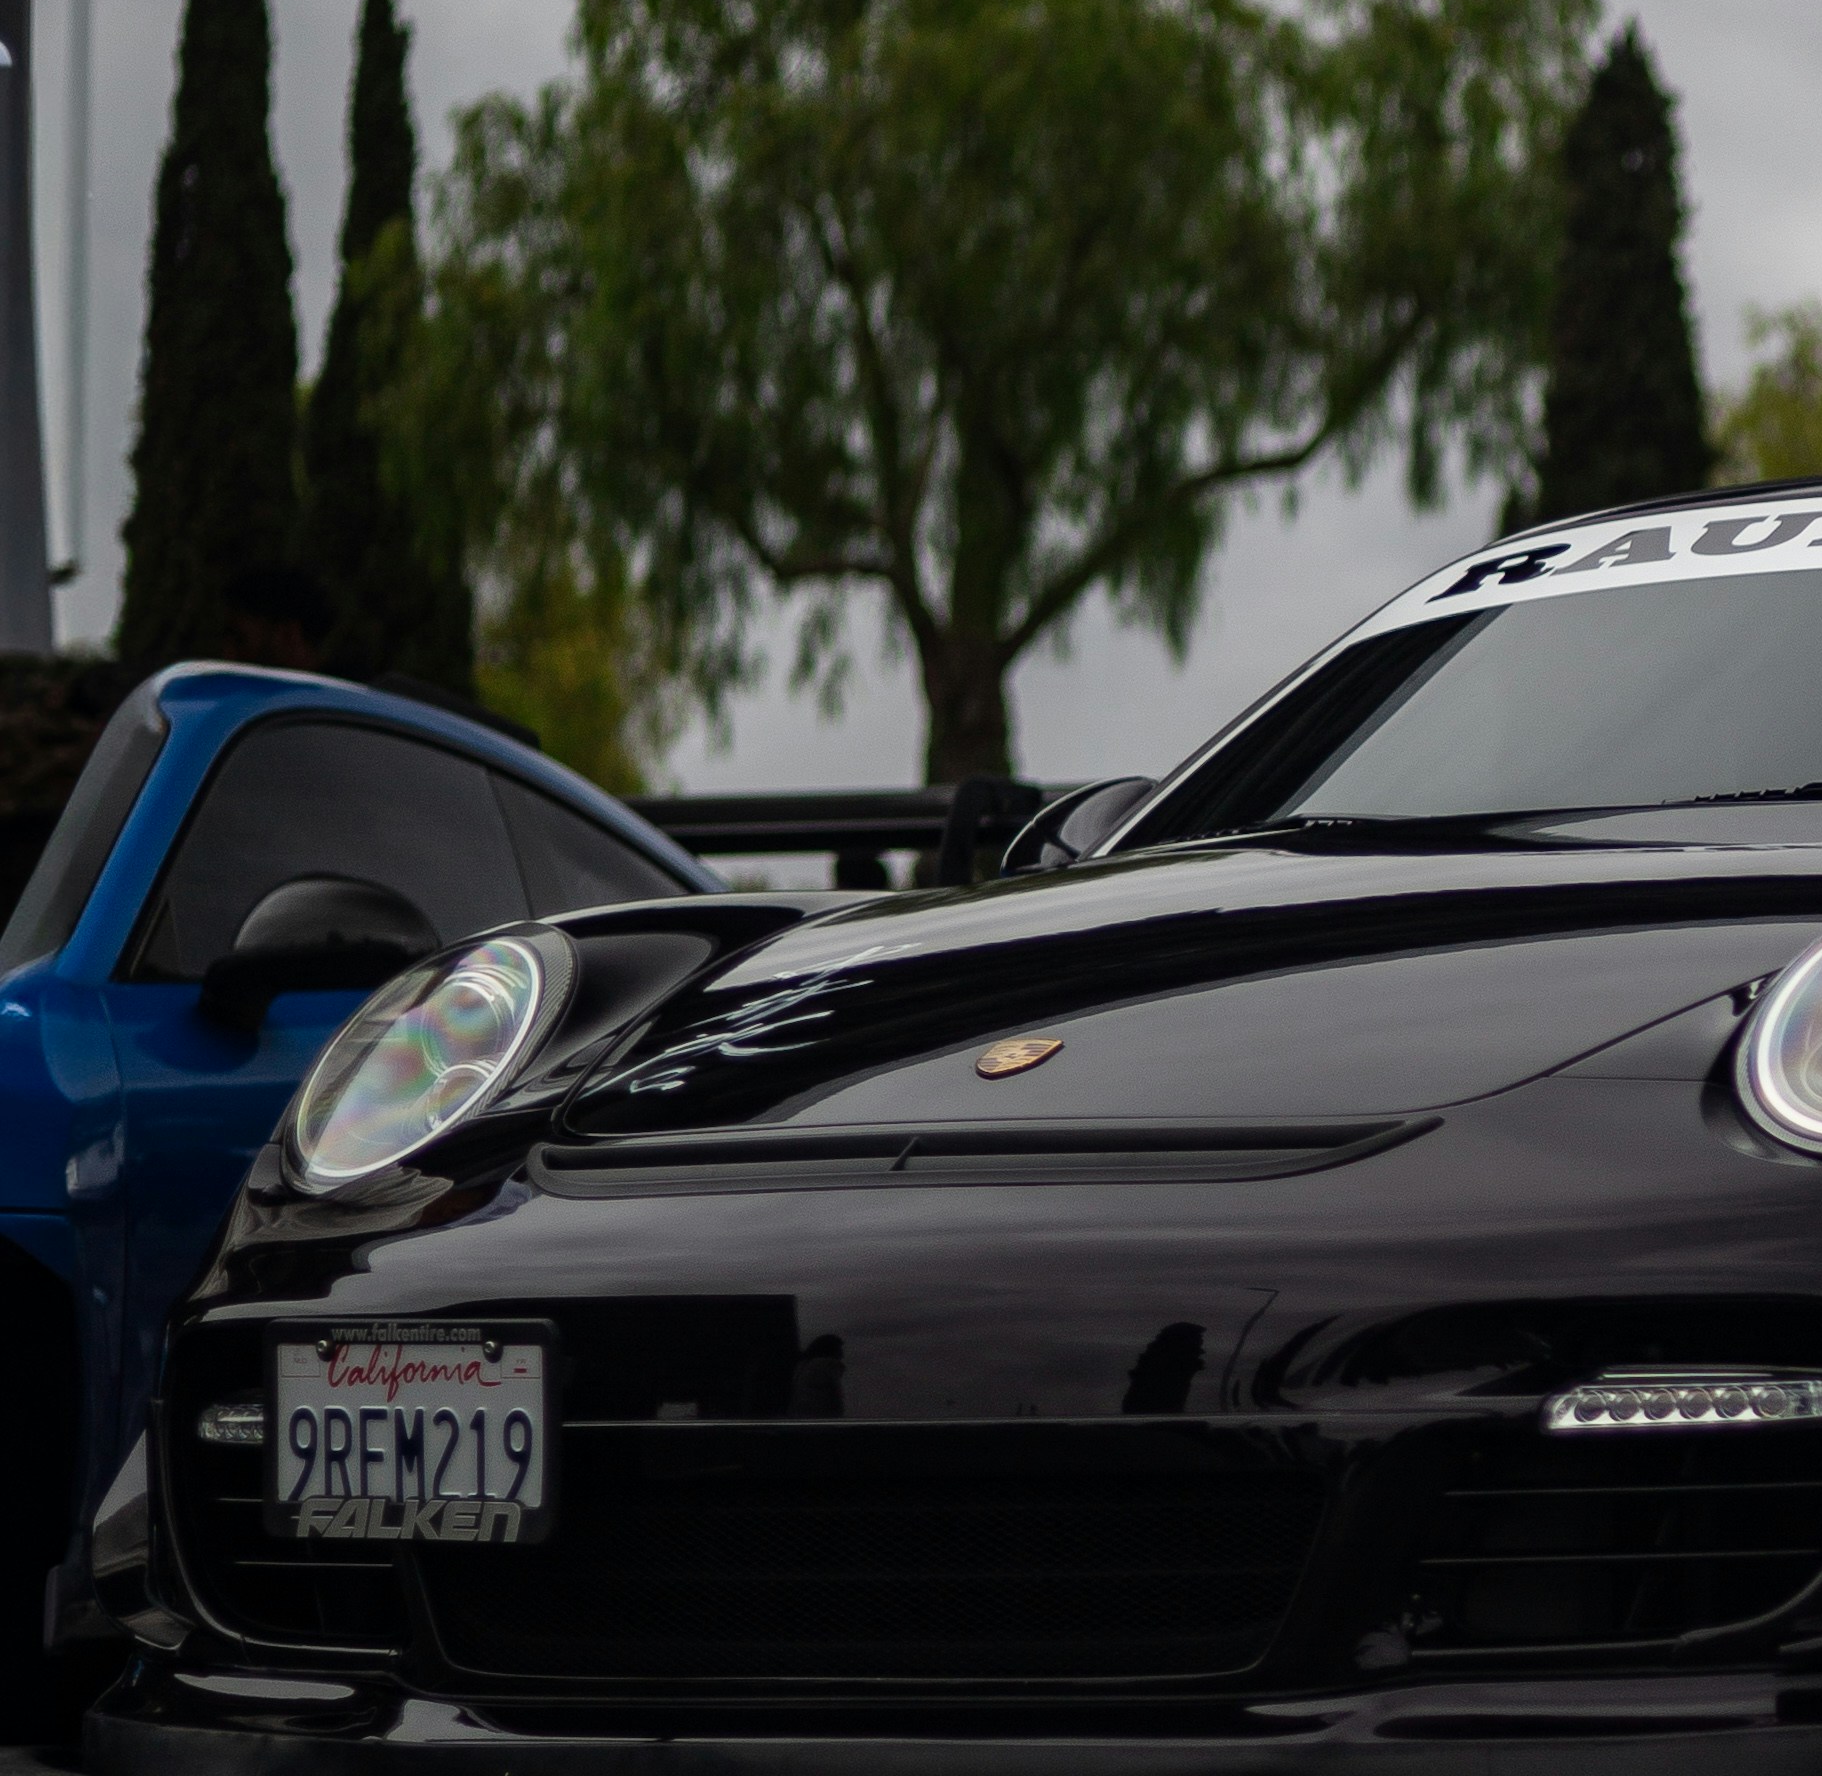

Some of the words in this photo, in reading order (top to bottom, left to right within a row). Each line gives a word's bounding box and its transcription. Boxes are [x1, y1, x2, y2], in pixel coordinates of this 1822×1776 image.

[330, 1323, 483, 1343] www.falkentire.com
[326, 1344, 502, 1403] California
[287, 1406, 533, 1503] 9RFM219
[291, 1497, 522, 1543] FALKEN
